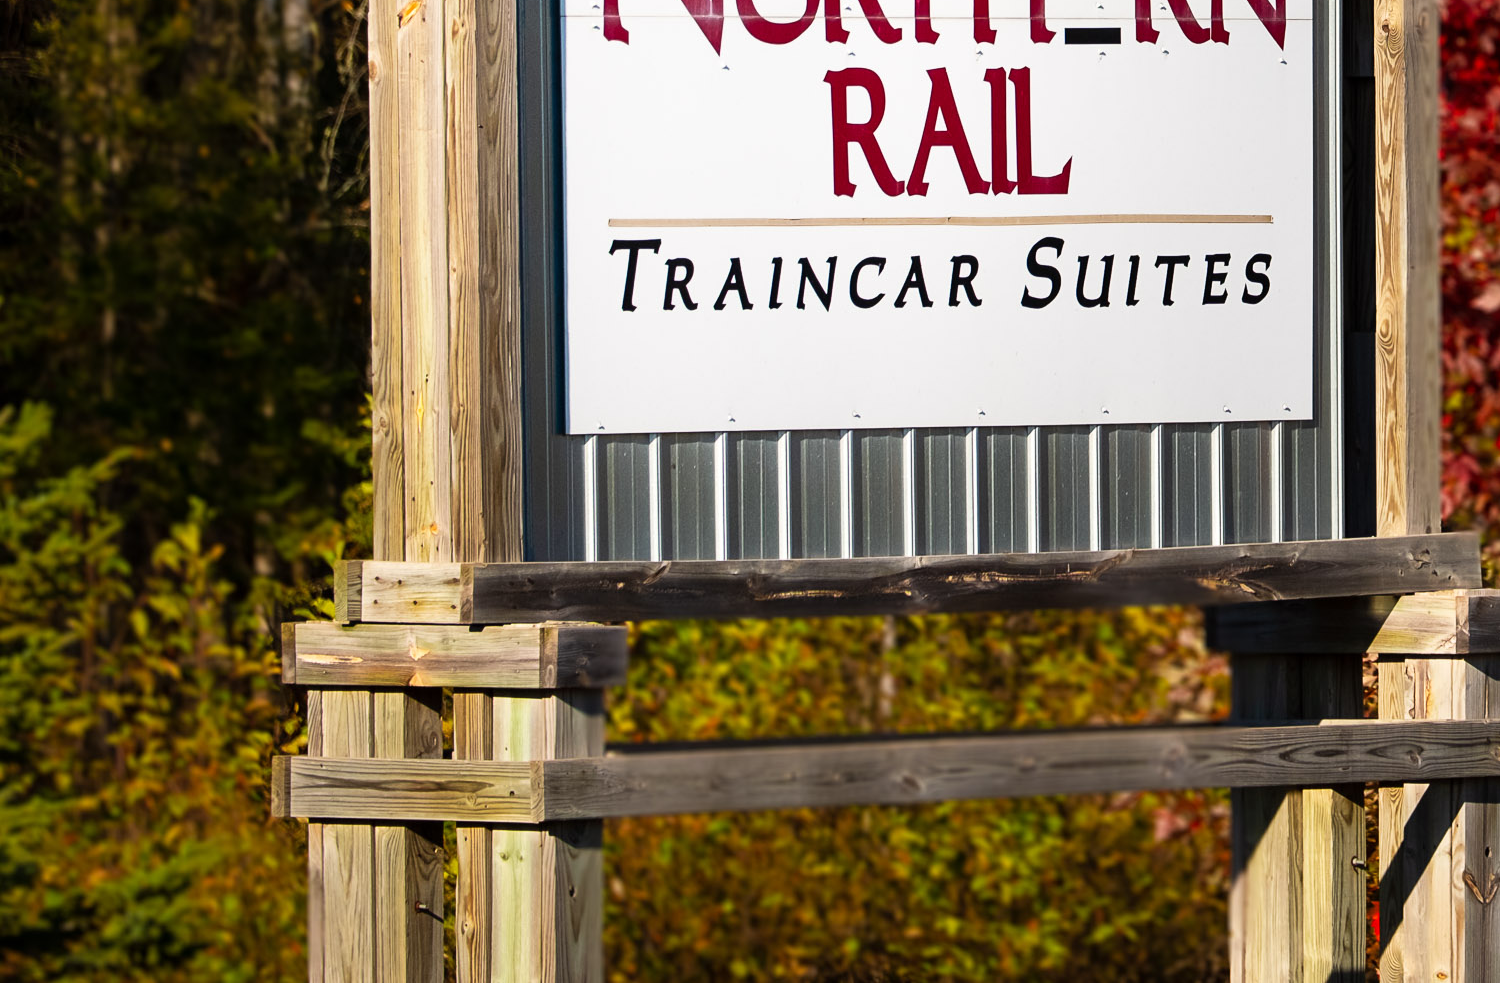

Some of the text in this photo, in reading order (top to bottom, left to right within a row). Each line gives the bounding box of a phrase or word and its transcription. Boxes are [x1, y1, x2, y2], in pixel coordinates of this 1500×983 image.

[823, 66, 1073, 197] RAIL
[608, 236, 1273, 312] TRAINCAR SUITES
